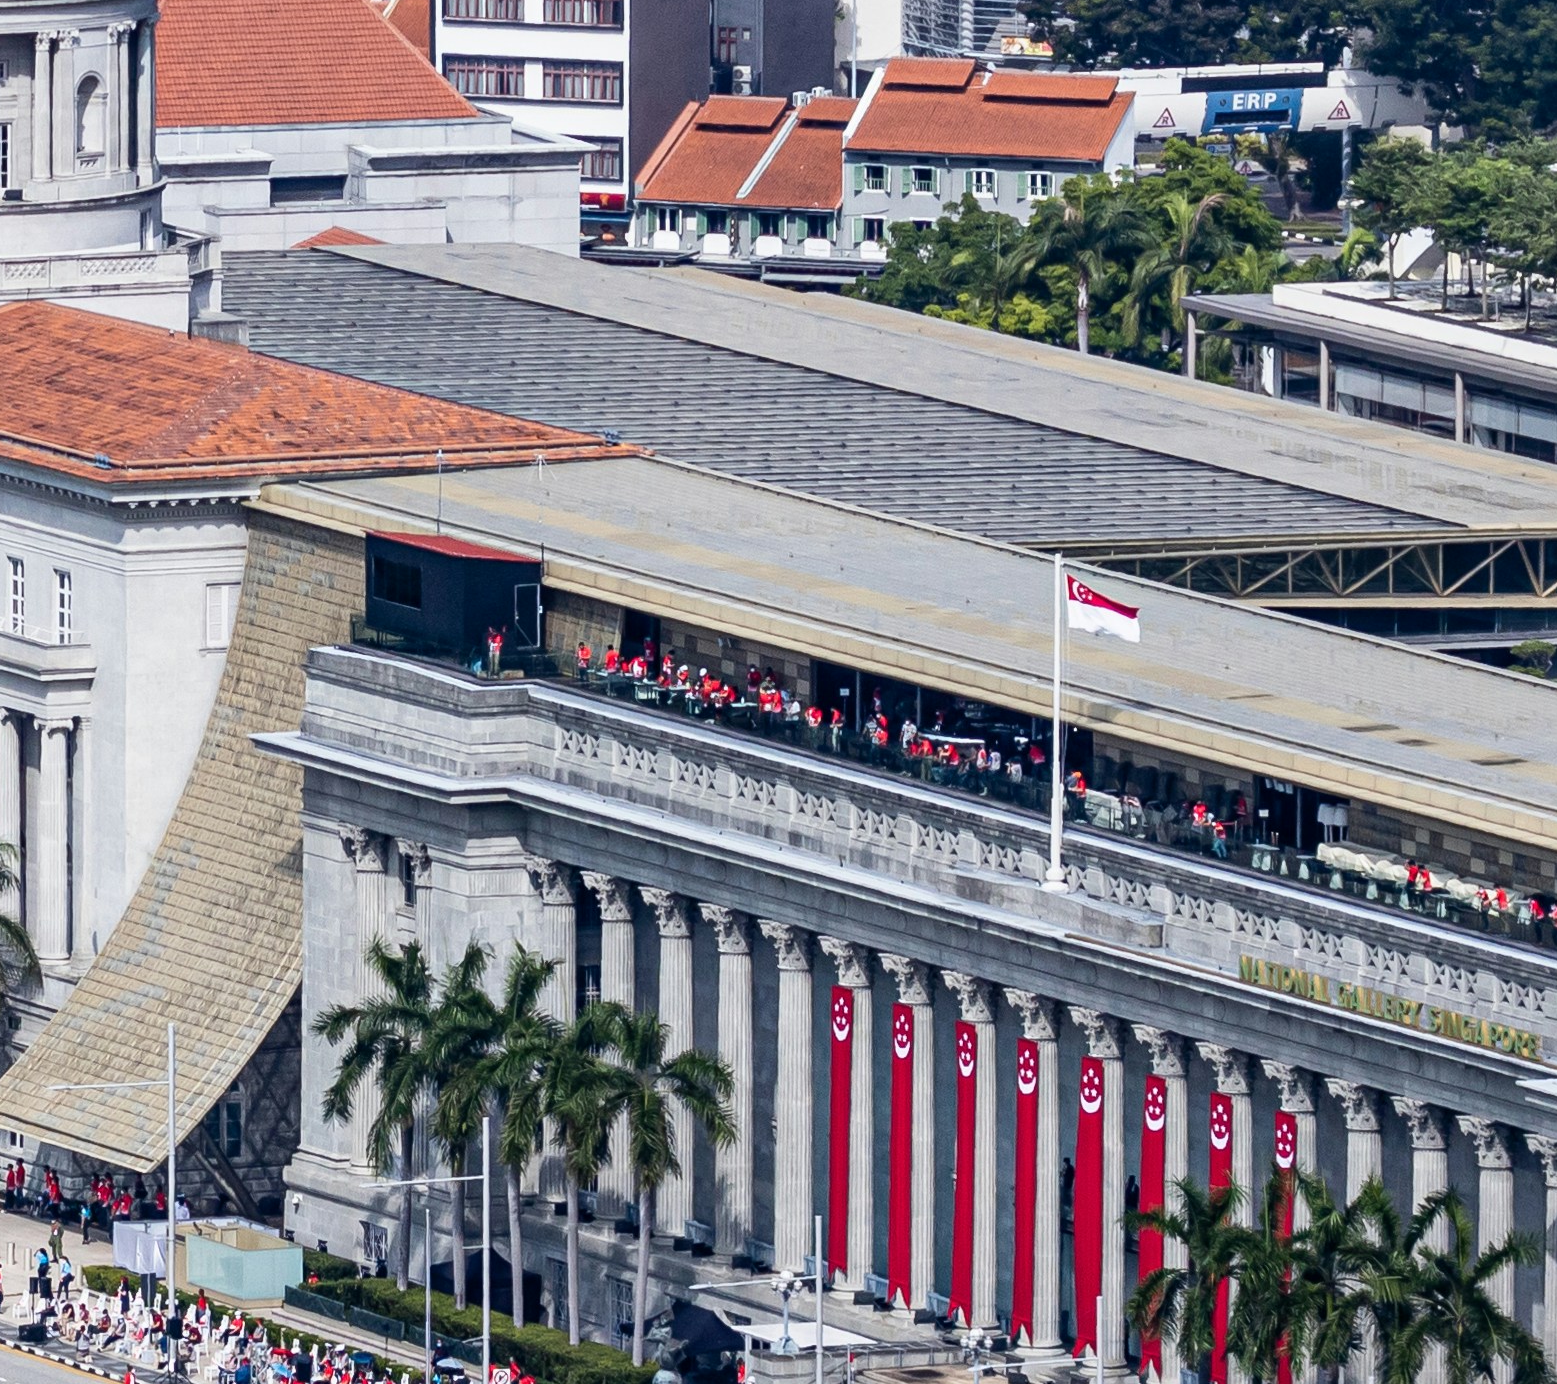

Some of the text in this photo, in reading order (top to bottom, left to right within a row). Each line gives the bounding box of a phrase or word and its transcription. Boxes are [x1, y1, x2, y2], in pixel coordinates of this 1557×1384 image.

[1233, 93, 1277, 110] ERP
[1337, 107, 1344, 117] R
[1162, 116, 1169, 125] R
[1239, 955, 1543, 1061] NATIONAL GALLERY SINGAPORE
